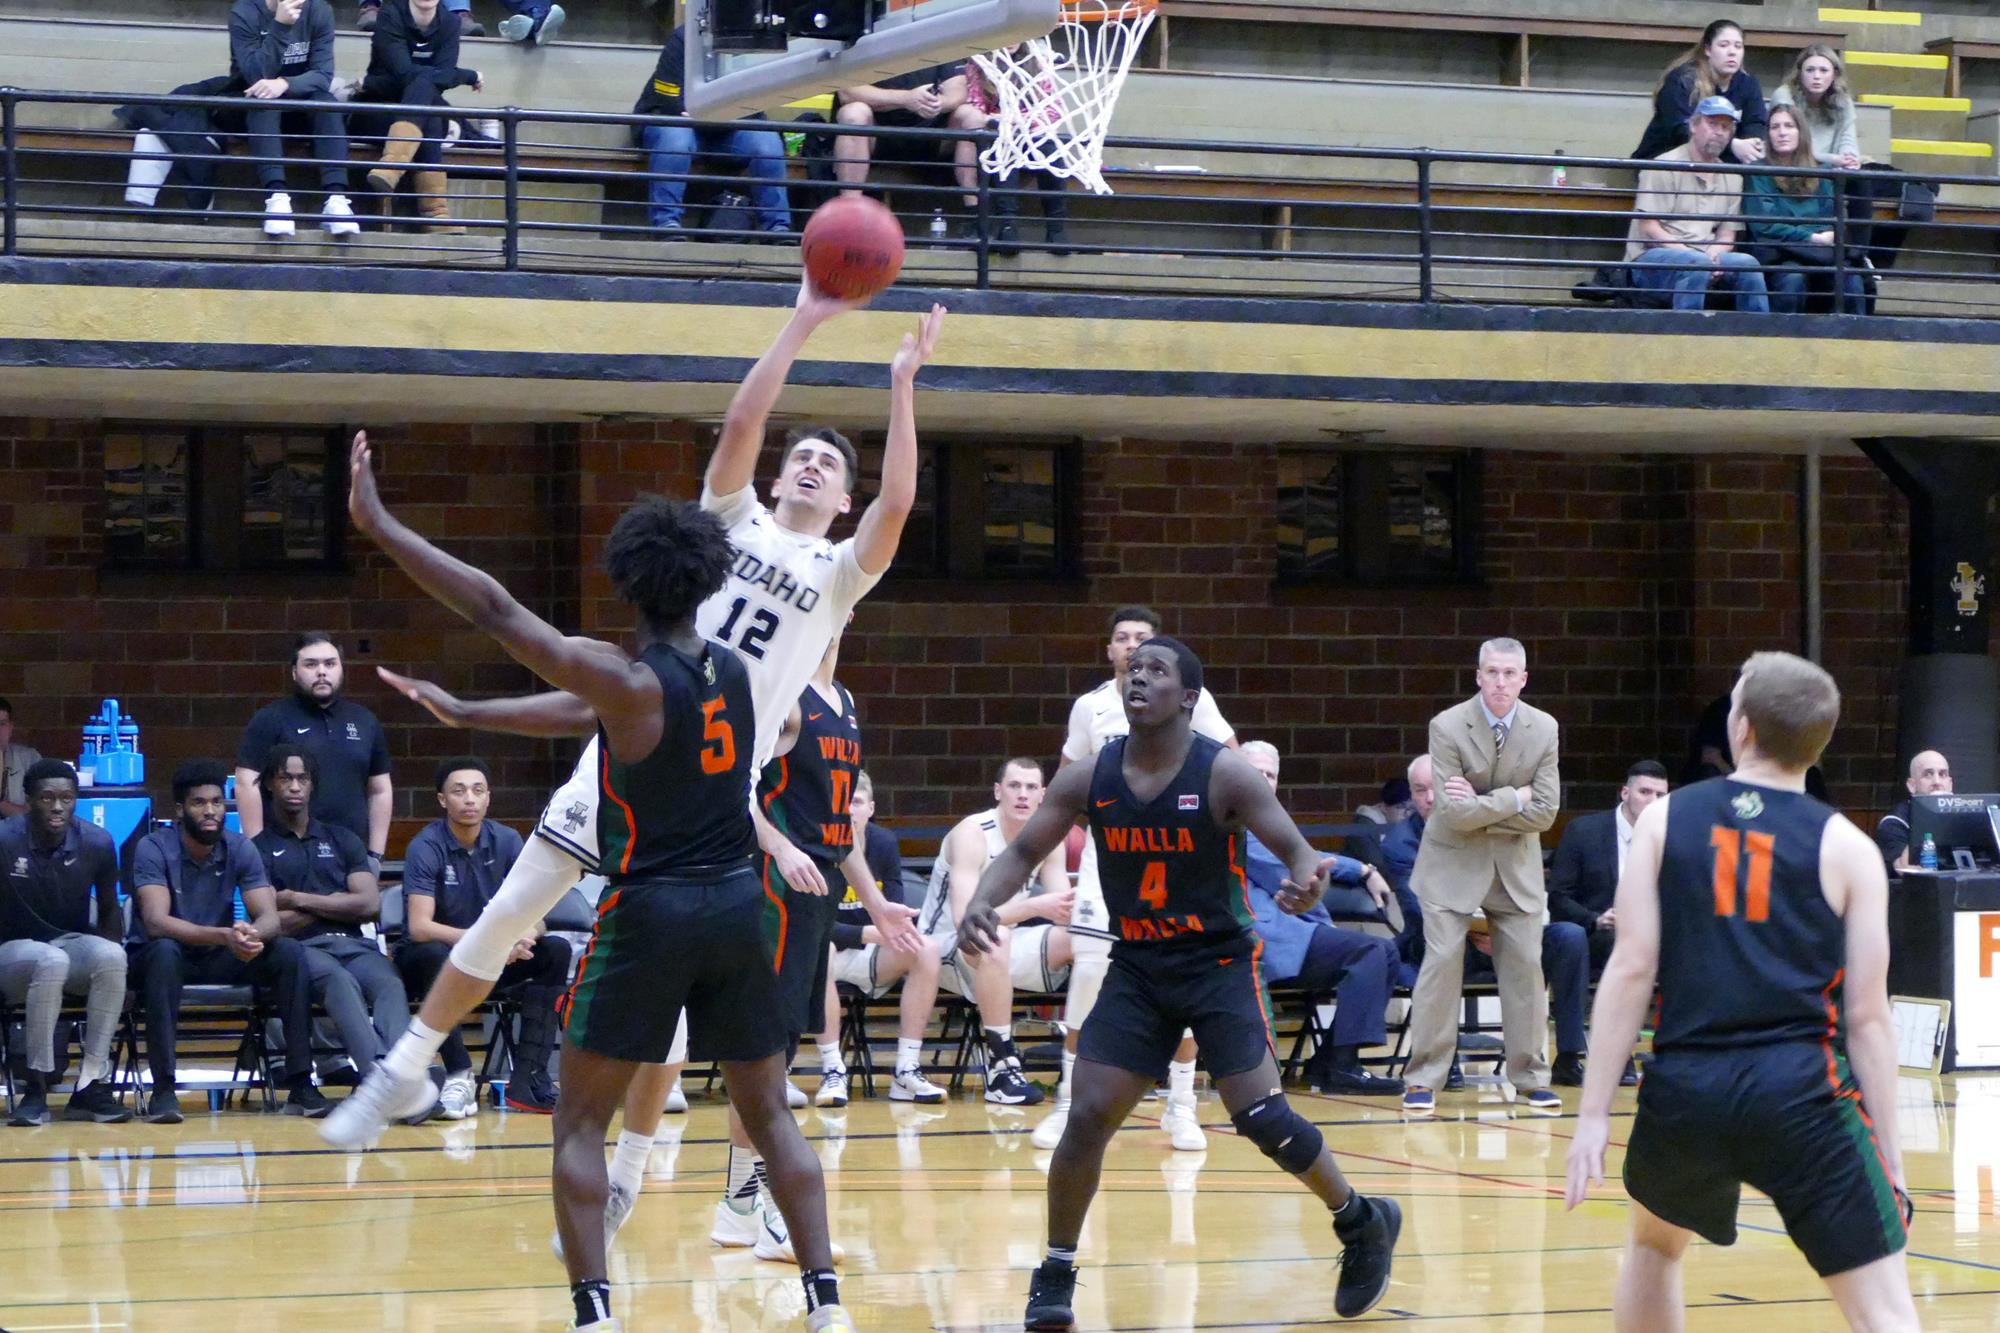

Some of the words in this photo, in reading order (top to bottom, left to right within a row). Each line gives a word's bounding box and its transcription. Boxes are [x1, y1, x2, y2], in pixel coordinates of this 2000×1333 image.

[736, 549, 820, 613] DAHO
[713, 595, 781, 663] 12
[700, 693, 736, 775] 5
[1103, 827, 1195, 853] WALLA
[1138, 861, 1168, 910] 4
[1711, 825, 1775, 922] 11
